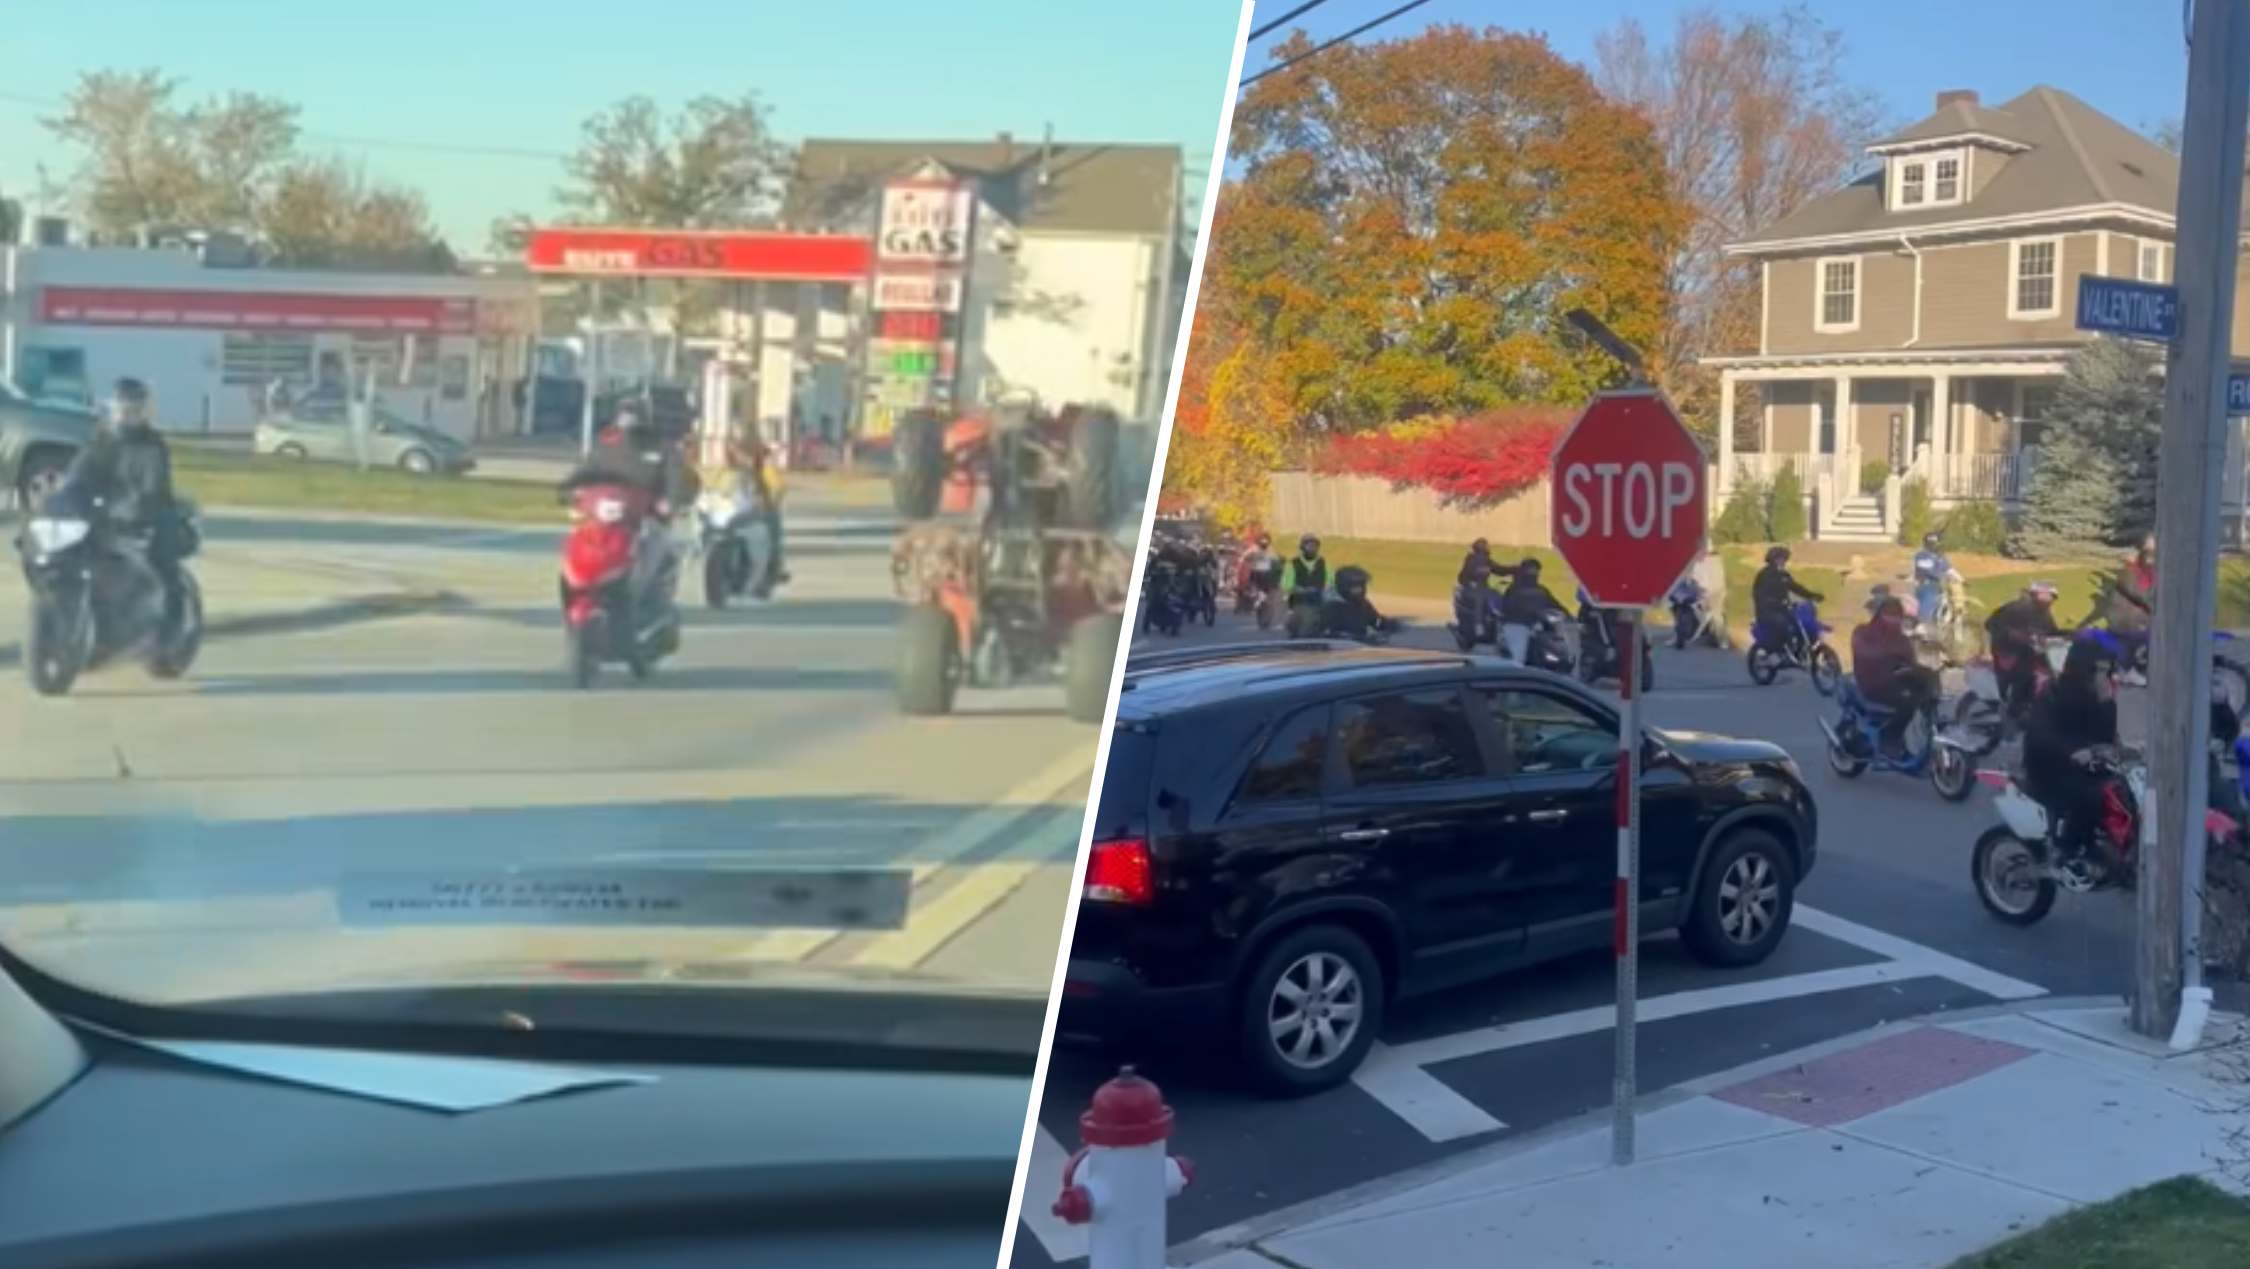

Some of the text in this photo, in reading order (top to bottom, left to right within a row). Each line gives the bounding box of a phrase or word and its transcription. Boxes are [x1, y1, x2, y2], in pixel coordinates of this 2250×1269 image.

[651, 239, 721, 268] GAS
[884, 229, 959, 253] GAS
[2084, 284, 2164, 330] VALENTINE
[2229, 379, 2250, 404] R
[1562, 462, 1695, 538] STOP
